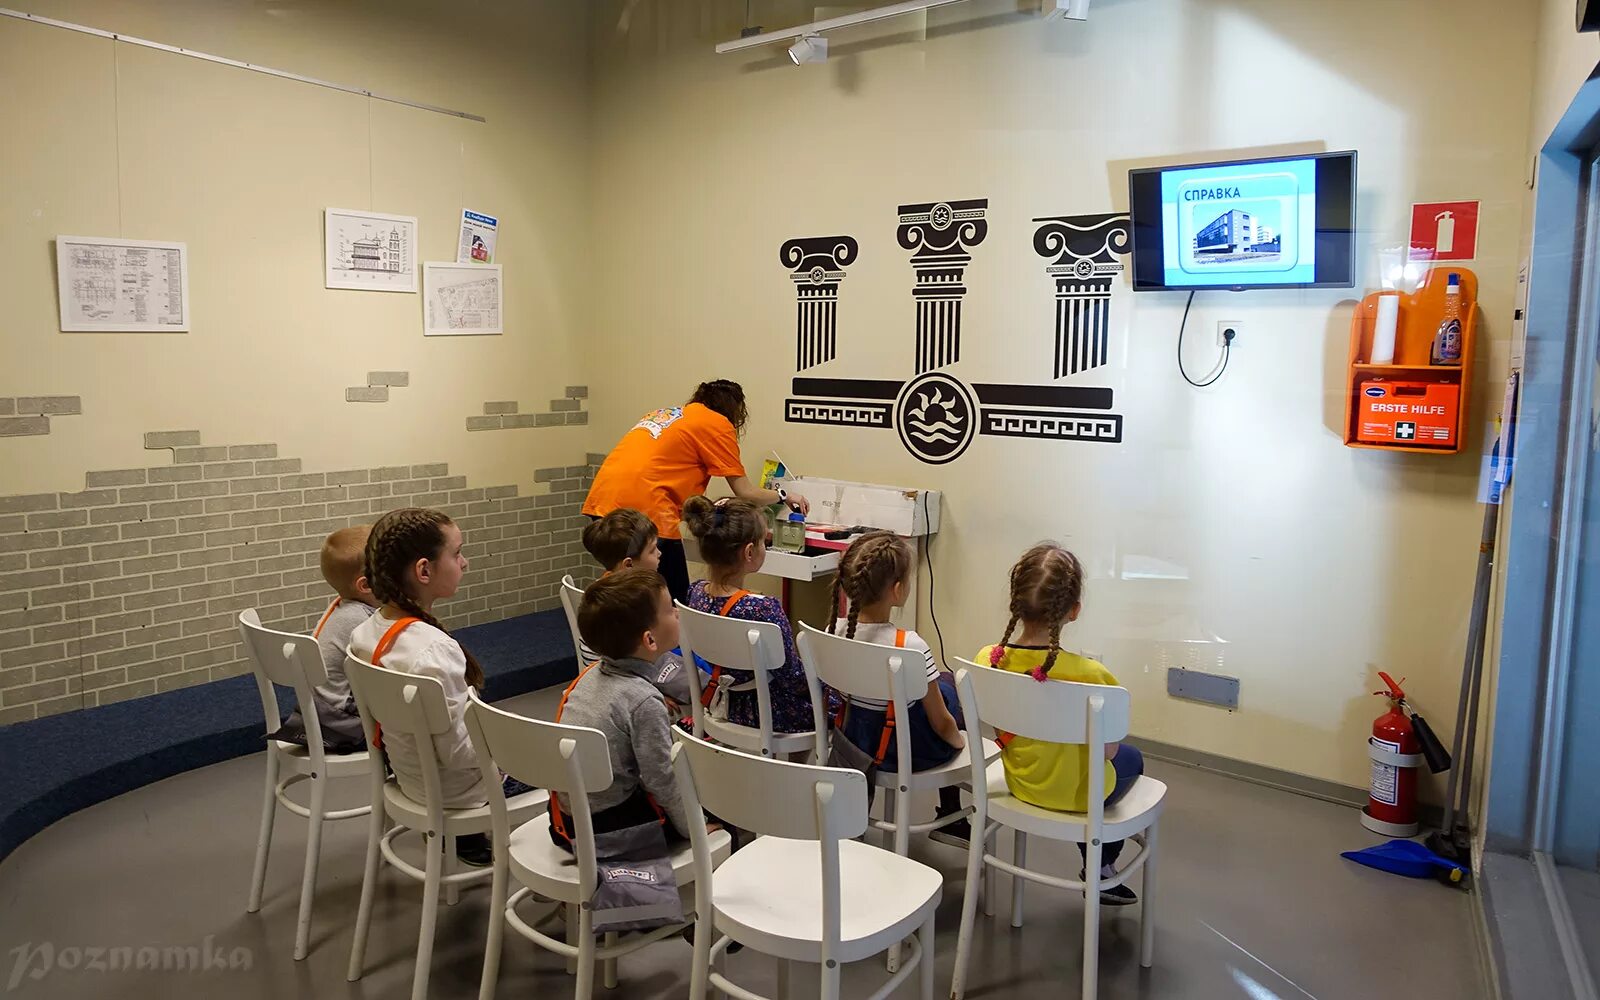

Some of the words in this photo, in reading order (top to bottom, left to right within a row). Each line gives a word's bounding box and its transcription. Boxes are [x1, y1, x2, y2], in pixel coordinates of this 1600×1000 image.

[1184, 187, 1241, 201] СПРАВКА
[1371, 403, 1408, 413] ERSTE
[1411, 405, 1445, 415] HILFE
